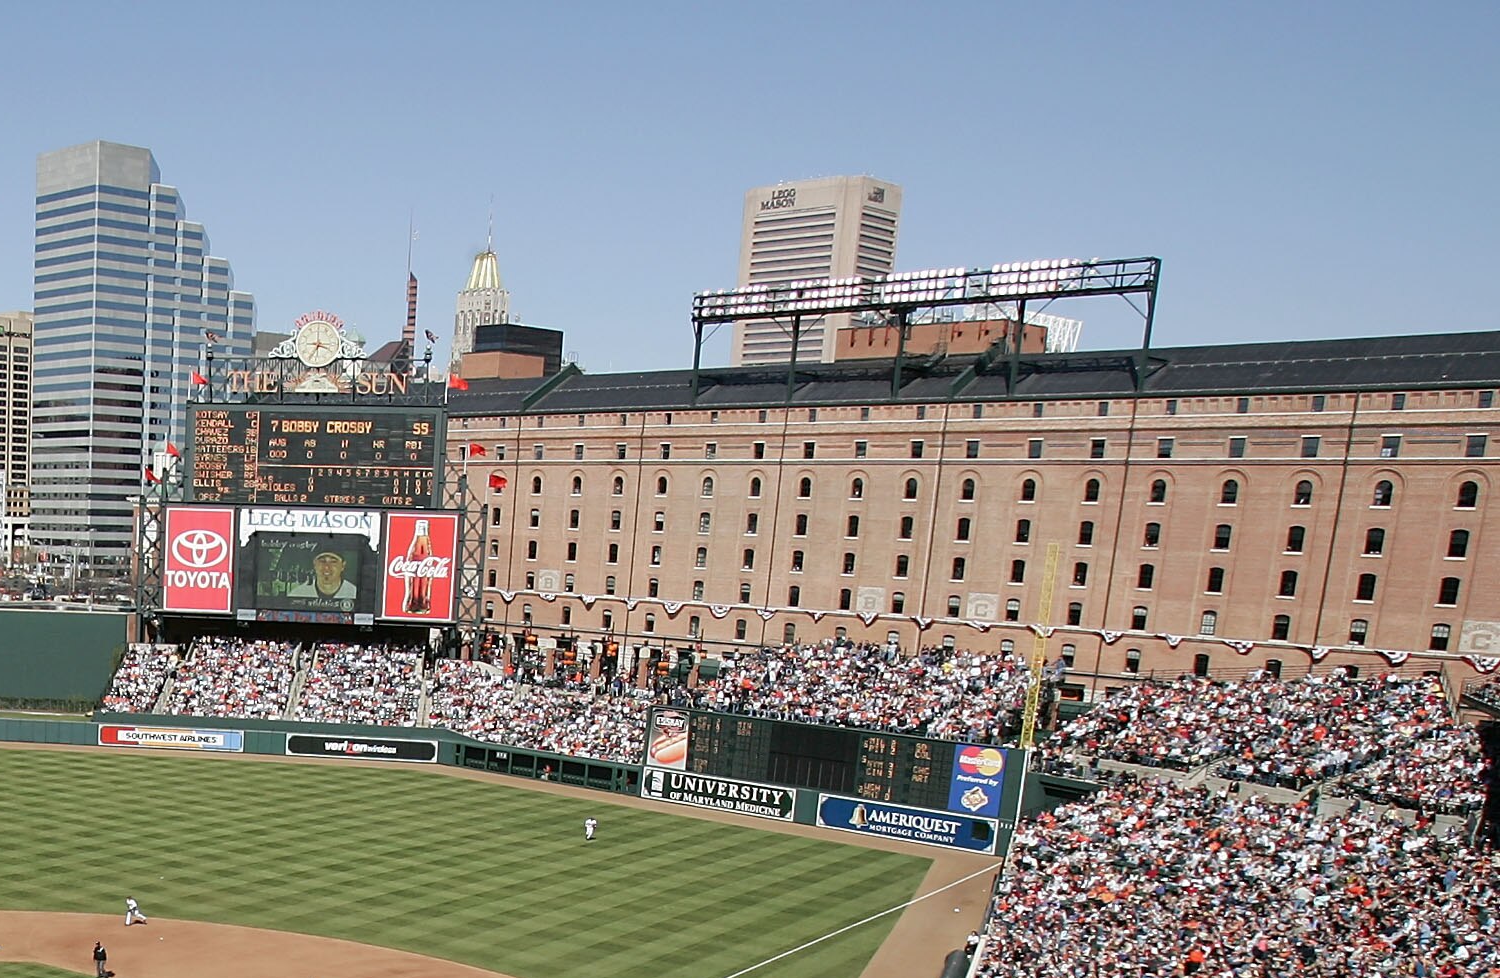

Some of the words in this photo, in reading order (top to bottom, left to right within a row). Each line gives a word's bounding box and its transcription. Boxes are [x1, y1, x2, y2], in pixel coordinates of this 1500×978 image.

[227, 371, 279, 393] THE
[356, 372, 409, 395] SUN
[271, 420, 279, 432] 7
[282, 420, 320, 433] BOBBY
[326, 421, 372, 434] CROSBY
[412, 422, 430, 435] SS
[248, 511, 296, 527] LEGG
[301, 513, 373, 529] MASON
[165, 569, 231, 589] TOYOTA
[126, 732, 177, 742] SOUTHWEST
[180, 734, 217, 744] AIRLINES
[325, 740, 367, 754] verizon
[669, 773, 784, 805] UNIVERSITY
[988, 778, 999, 787] by
[669, 791, 682, 800] OF
[682, 792, 734, 810] MARYLAND
[735, 801, 781, 817] MEDICINE
[868, 809, 962, 835] AMERIQUEST
[869, 824, 913, 838] MORTGAGE
[914, 830, 956, 844] COMPANY
